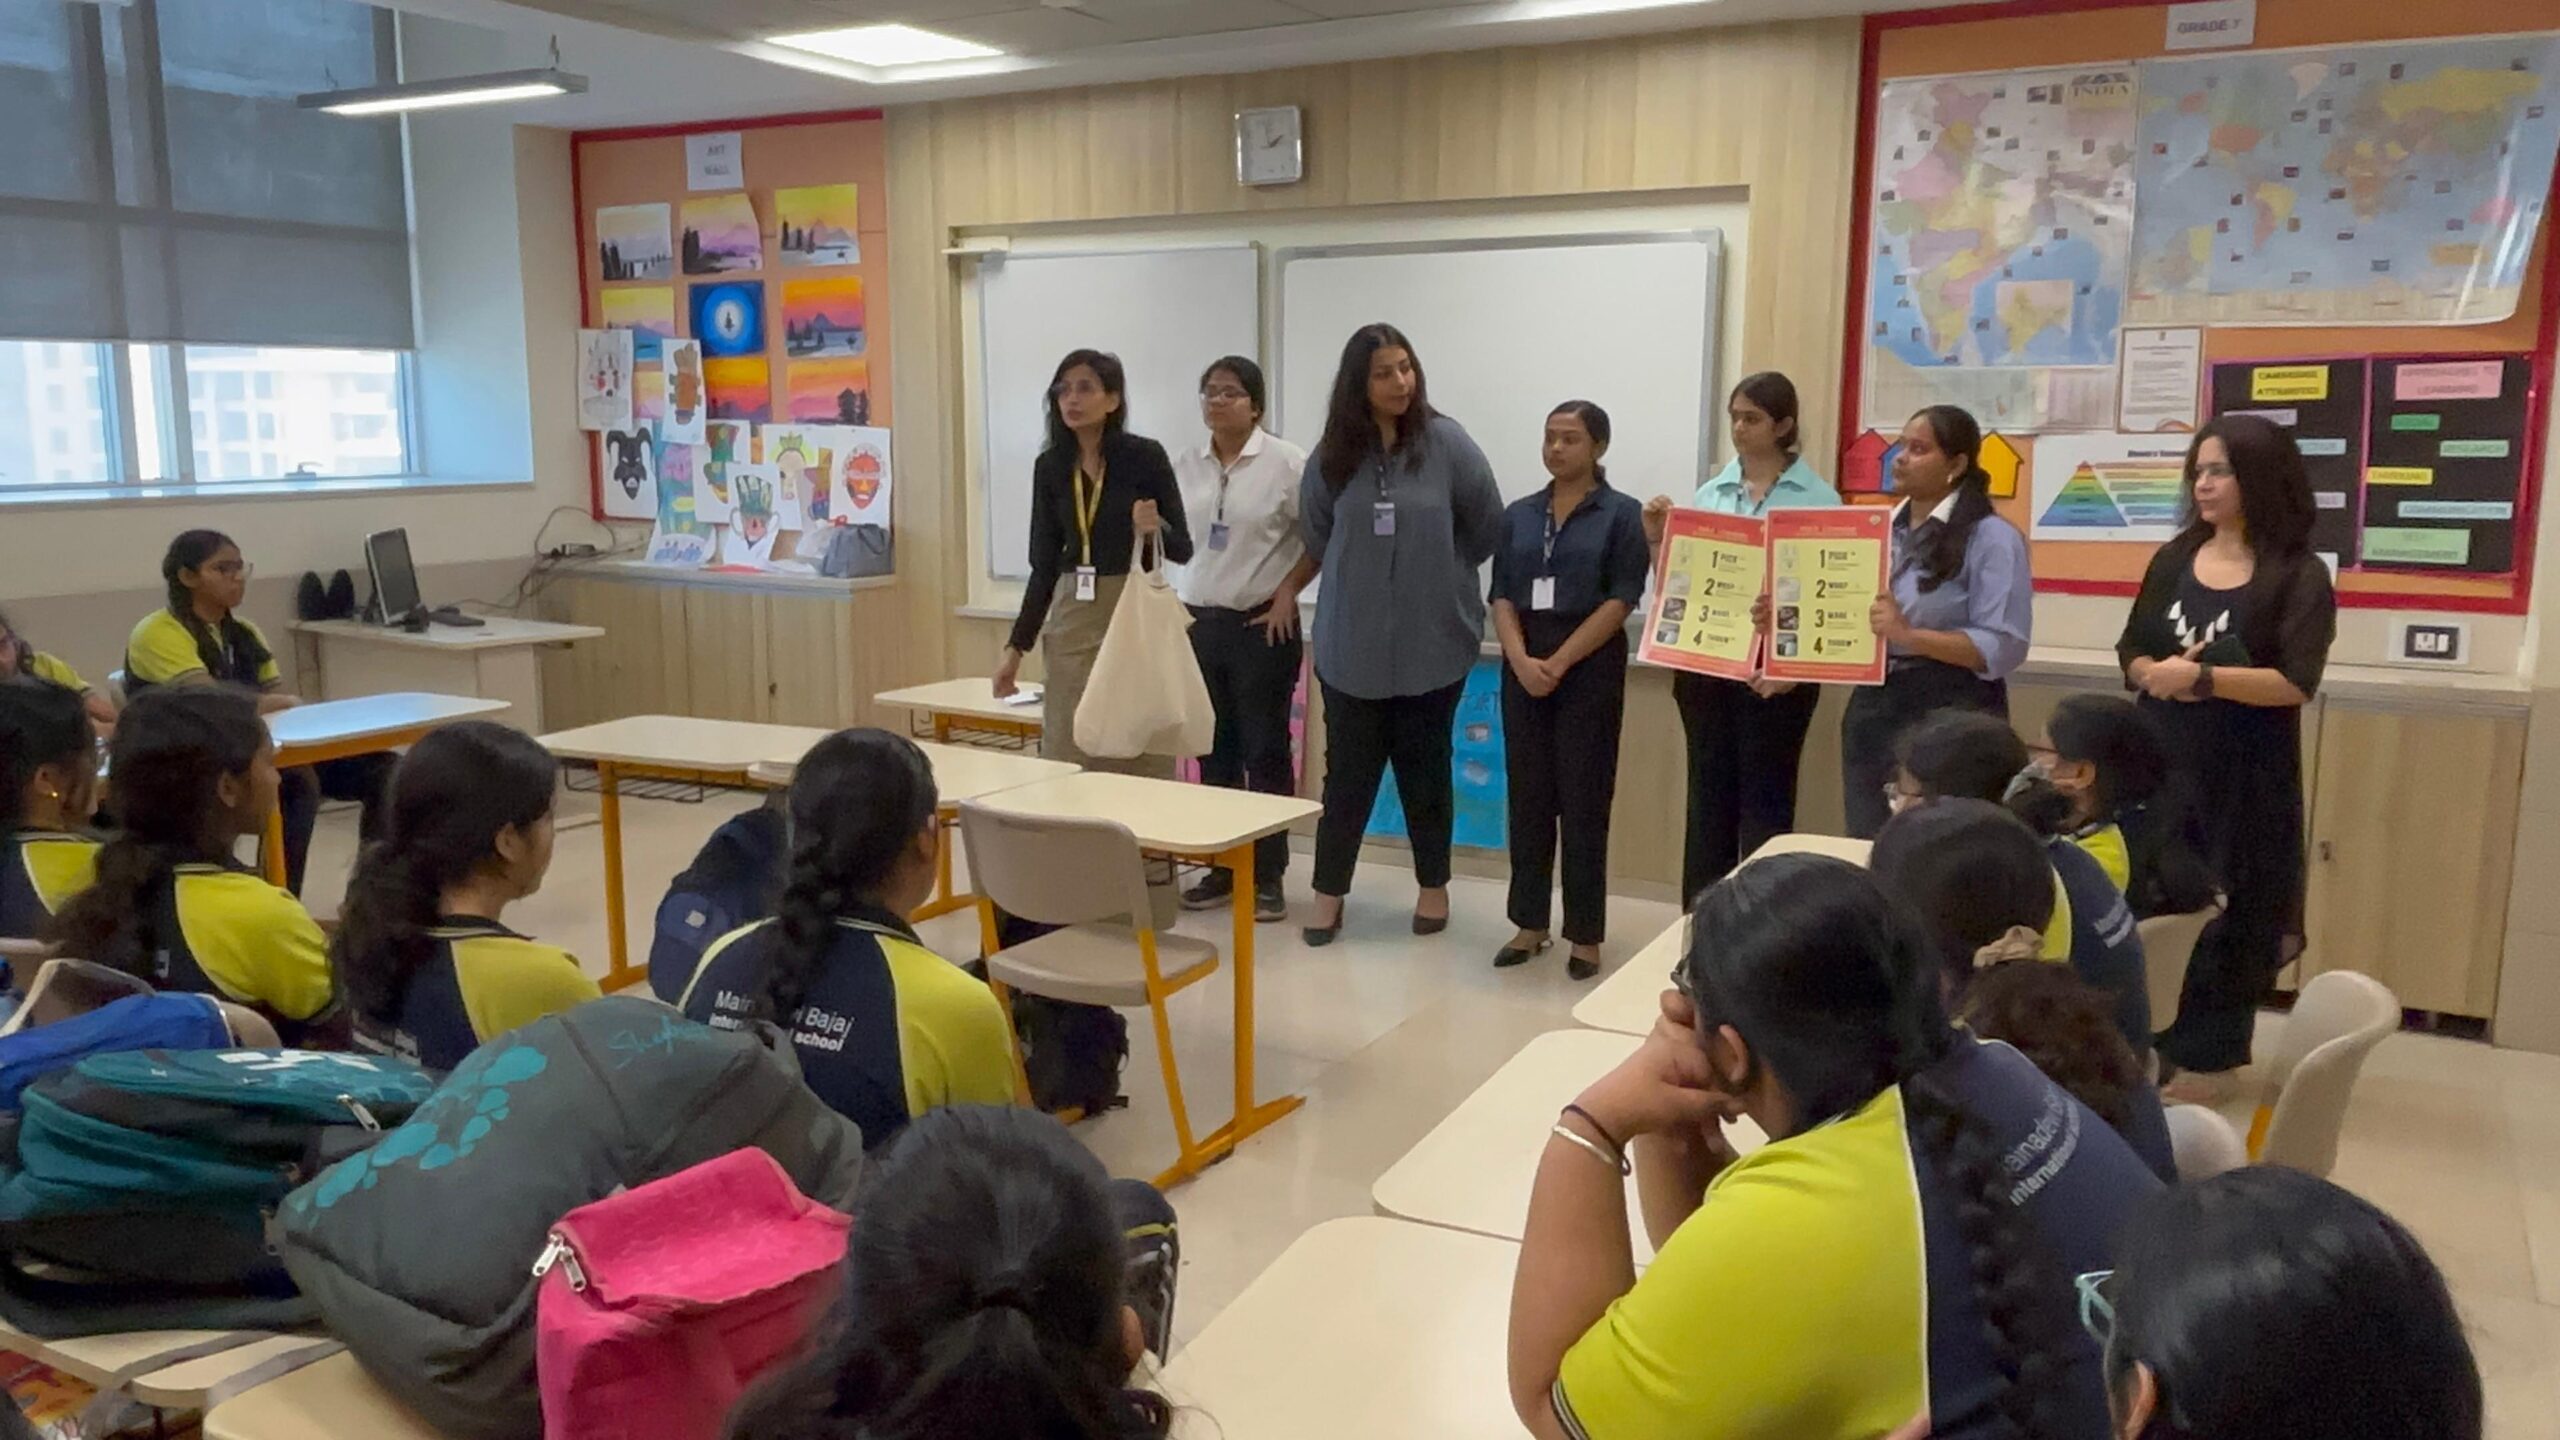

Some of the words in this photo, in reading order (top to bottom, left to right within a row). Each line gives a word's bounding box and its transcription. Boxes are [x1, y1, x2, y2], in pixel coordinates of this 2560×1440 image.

[2177, 20, 2227, 34] GRADE
[2074, 84, 2129, 97] INDIA
[1712, 550, 1719, 569] 1
[1820, 549, 1826, 569] 1
[1703, 577, 1716, 596] 2
[1815, 578, 1826, 598] 2
[1698, 604, 1709, 623] 3
[1814, 608, 1825, 628] 3
[1693, 629, 1703, 646] 4
[1813, 636, 1823, 655] 4
[806, 1006, 856, 1038] Bajaj
[795, 1031, 844, 1052] school
